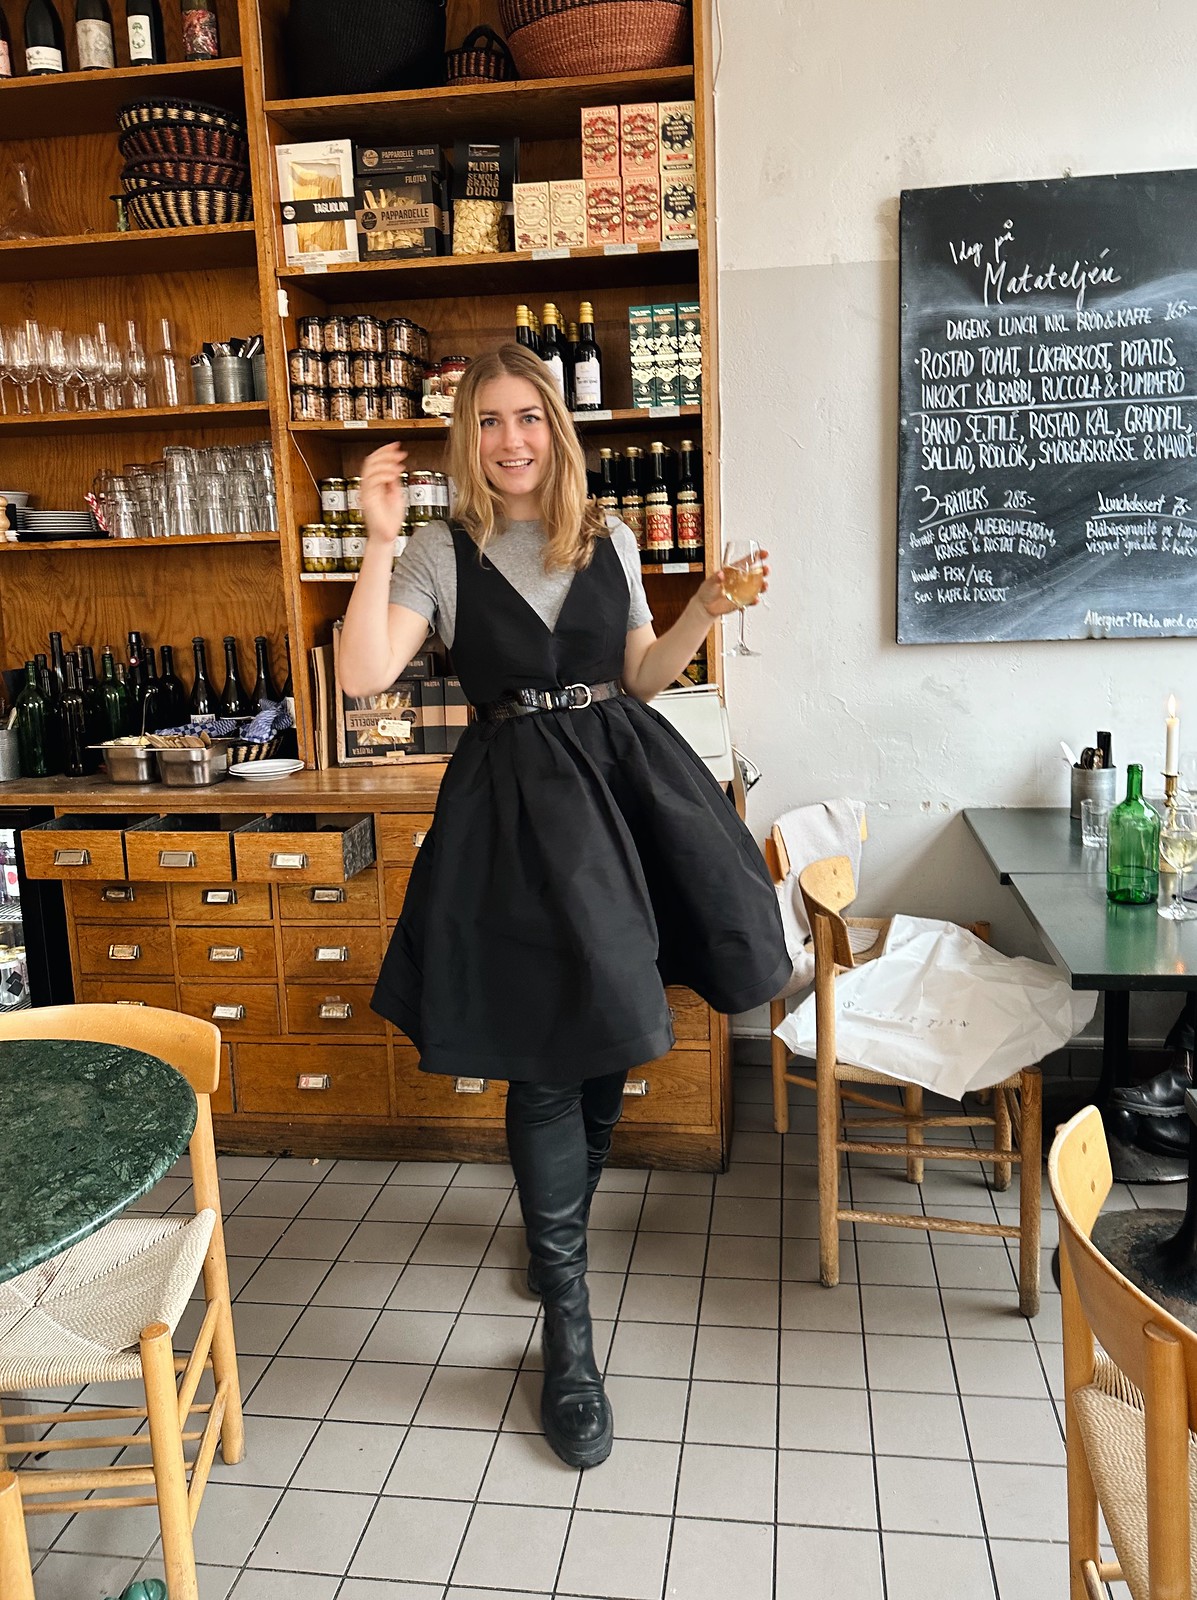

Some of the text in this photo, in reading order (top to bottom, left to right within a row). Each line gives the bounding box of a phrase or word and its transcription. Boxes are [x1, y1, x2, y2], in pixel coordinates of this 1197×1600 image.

[381, 150, 414, 158] PAPPARDELLE
[405, 174, 427, 183] FILOTEA
[466, 187, 499, 197] DURO
[313, 202, 349, 214] TAGLIOLINI
[381, 208, 428, 220] PAPPARDELLE
[994, 218, 1015, 264] på
[946, 319, 992, 341] DAGENS
[999, 314, 1038, 336] LUNCH
[1044, 313, 1070, 332] INKL
[920, 337, 1177, 380] ROSTAD TOMAT, LÖKFÄRSKOST, POTATIS,
[922, 384, 971, 409] INKOKT
[976, 379, 1036, 407] KÅLRABBI,
[1041, 373, 1102, 402] RUCCOLA
[920, 414, 962, 446] BAKAD
[1029, 412, 1081, 440] ROSTAD
[1086, 406, 1122, 438] KÅL,
[1124, 404, 1193, 434] GRÄDDFIL,
[921, 446, 976, 474] SALLAD,
[979, 443, 1036, 471] RÖDLÖK,
[1038, 436, 1139, 465] SMÖRGÅSKRASSE
[1157, 432, 1197, 460] MANDE
[1097, 490, 1166, 513] Lunchdessert
[934, 539, 970, 561] KRASSE
[984, 536, 1016, 553] ROSTAT
[1018, 537, 1047, 560] BRÖD
